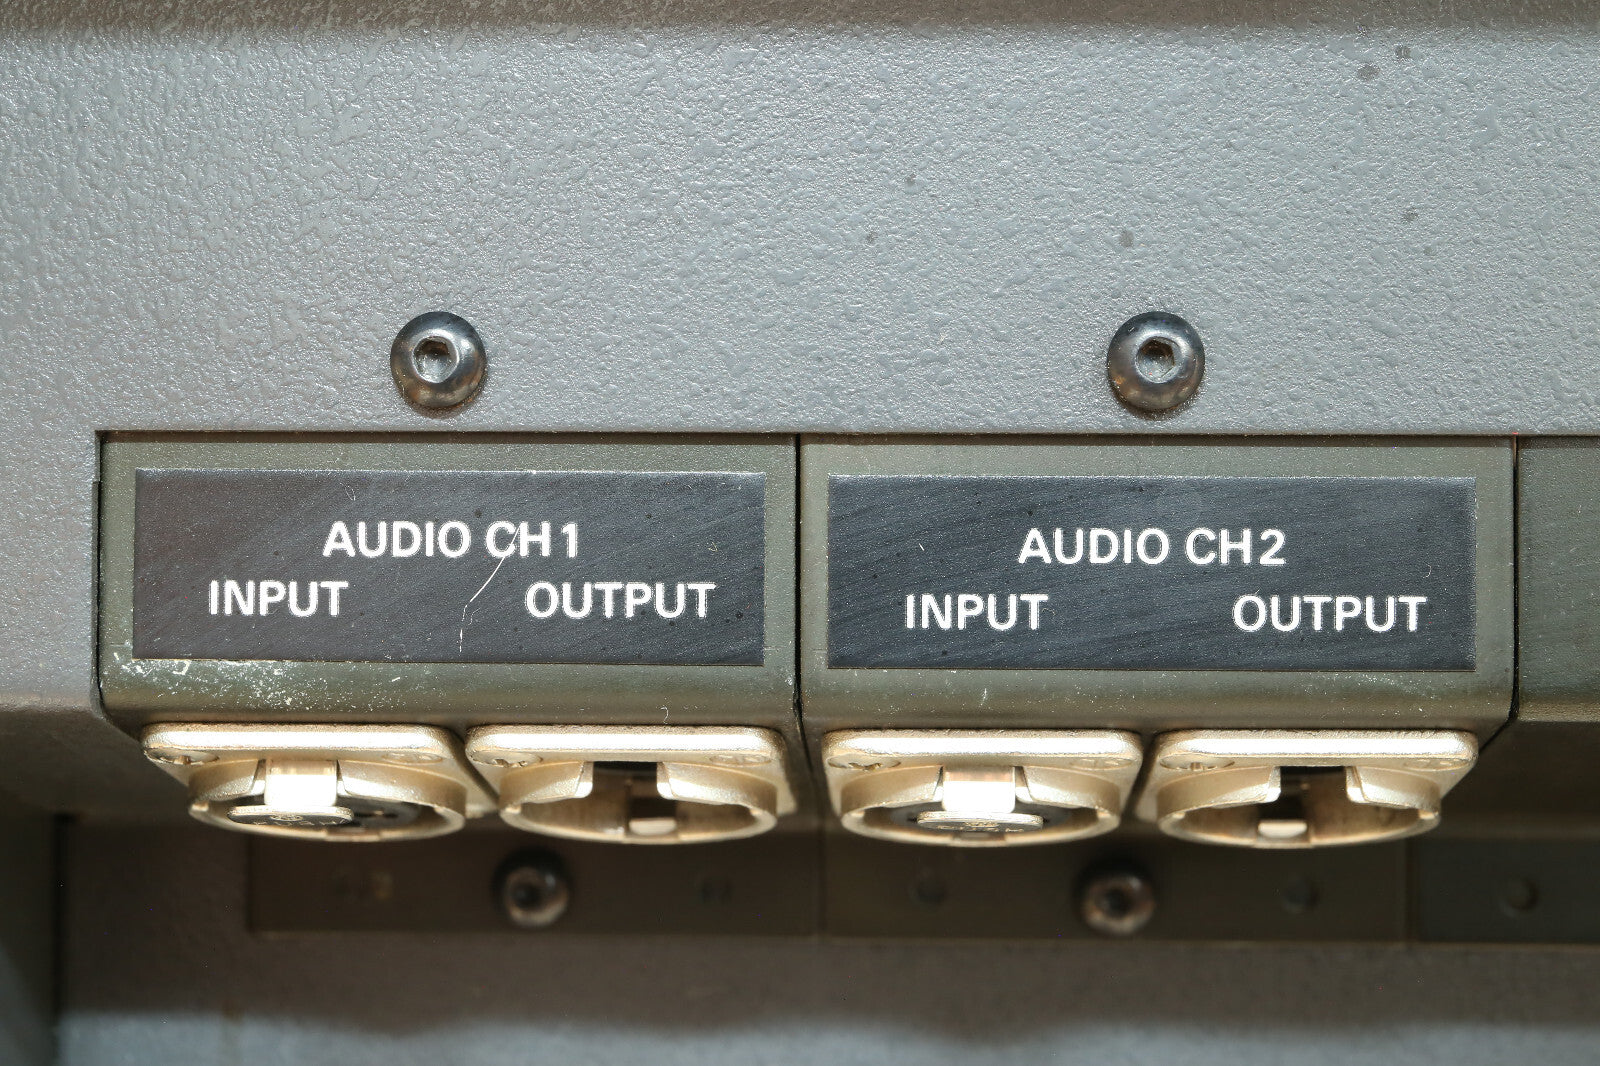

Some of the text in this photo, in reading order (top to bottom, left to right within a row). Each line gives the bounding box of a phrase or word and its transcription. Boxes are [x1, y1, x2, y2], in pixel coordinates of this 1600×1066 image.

[321, 518, 472, 560] AUDIO
[1016, 526, 1172, 566] AUDIO
[207, 578, 350, 618] INPUT
[523, 579, 717, 620] OUTPUT
[905, 592, 1050, 632] INPUT
[1231, 593, 1428, 634] OUTPUT
